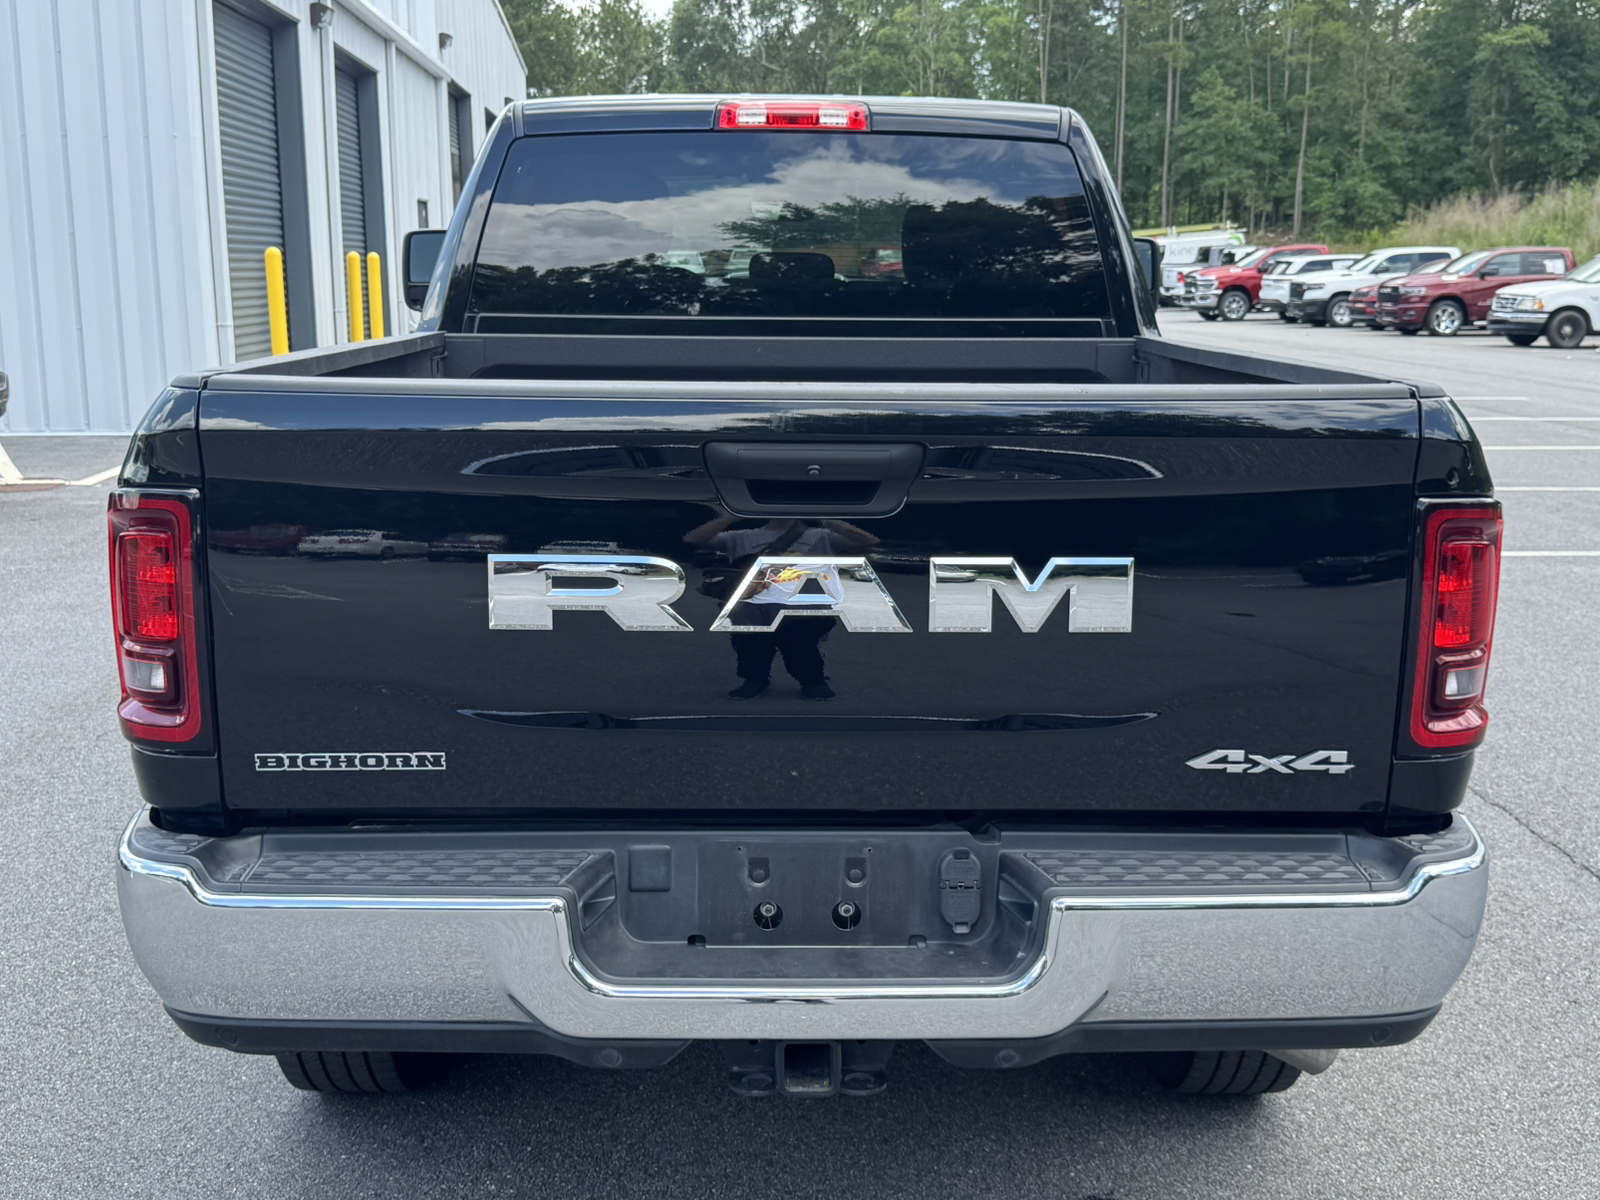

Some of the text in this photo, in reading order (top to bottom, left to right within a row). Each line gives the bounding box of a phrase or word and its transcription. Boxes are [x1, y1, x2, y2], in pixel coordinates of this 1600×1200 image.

[487, 553, 1135, 633] RAM
[254, 752, 446, 771] BIGHORN
[1184, 749, 1356, 774] 4x4
